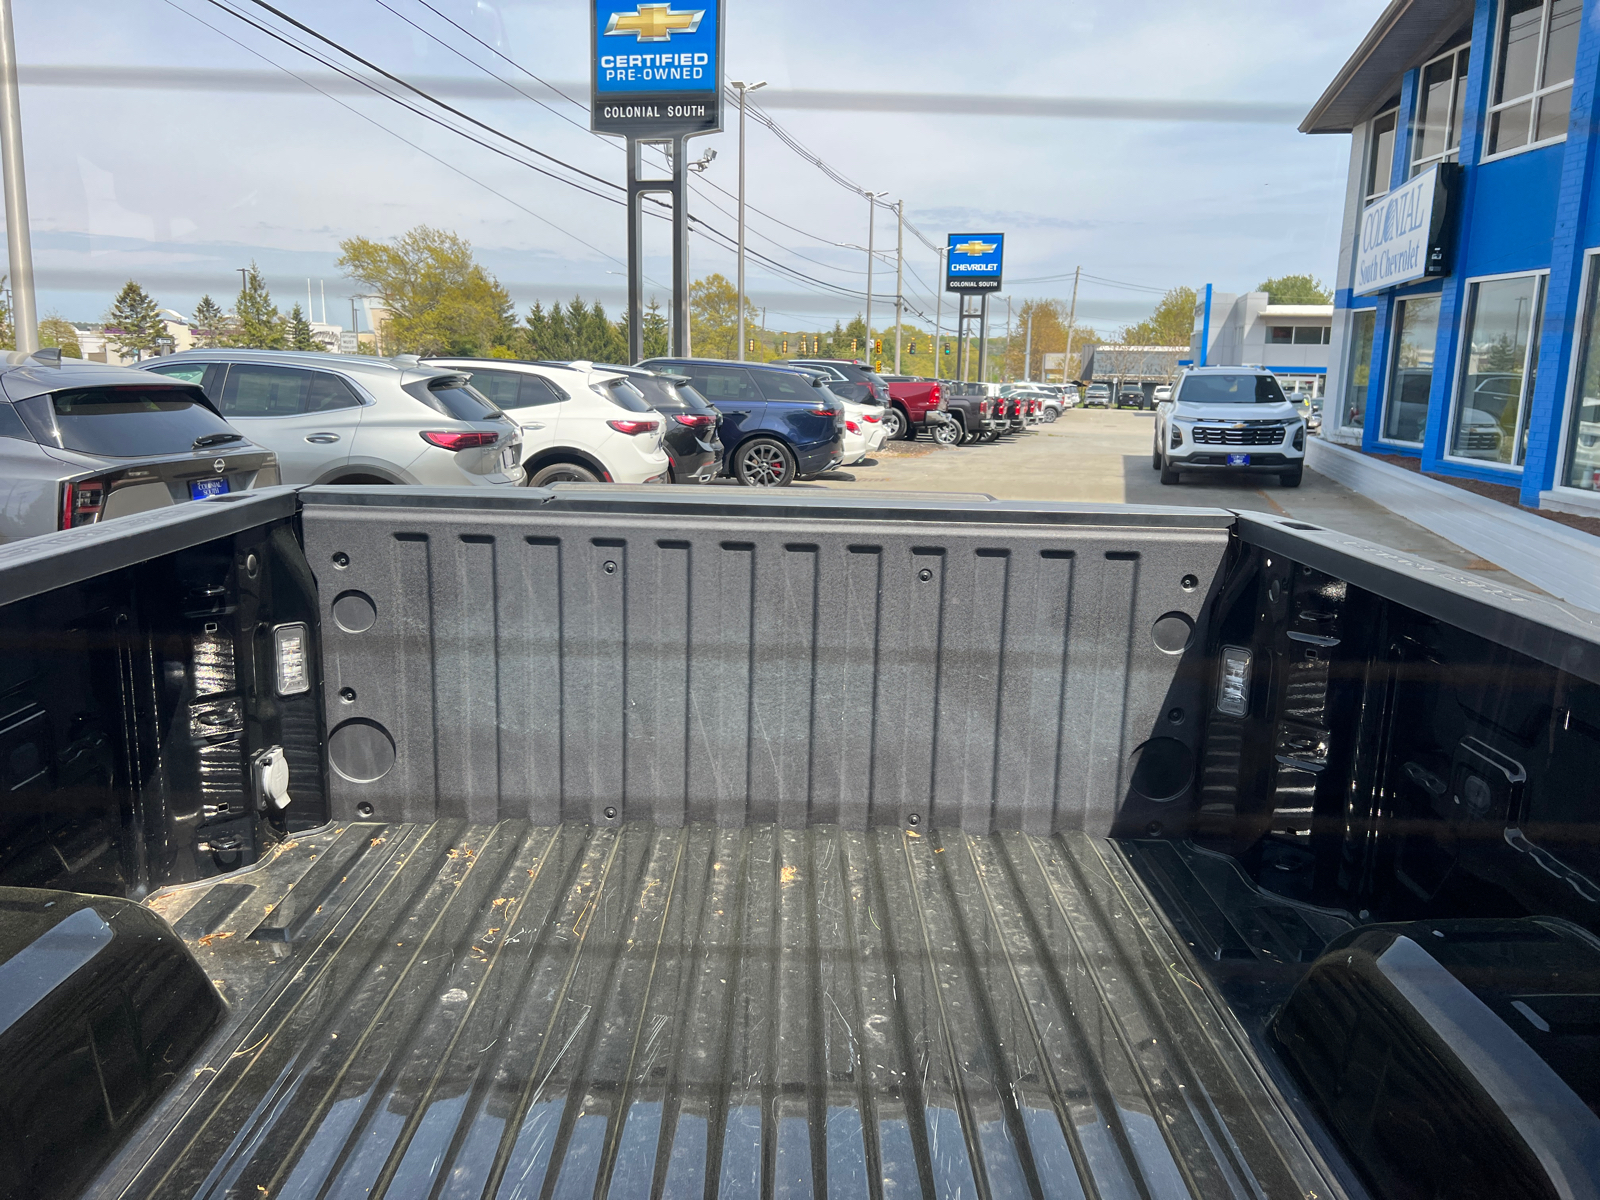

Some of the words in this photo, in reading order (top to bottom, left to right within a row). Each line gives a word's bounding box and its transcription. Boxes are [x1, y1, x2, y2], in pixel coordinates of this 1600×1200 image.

[601, 53, 708, 68] CERTIFIED
[606, 67, 703, 81] PRE-OWNED
[604, 106, 660, 118] COLONIAL
[667, 105, 705, 117] SOUTH
[1363, 183, 1424, 254] COLONIAL
[951, 263, 998, 271] CHEVROLET
[1359, 254, 1379, 286] South
[1380, 239, 1420, 279] Chevrolet
